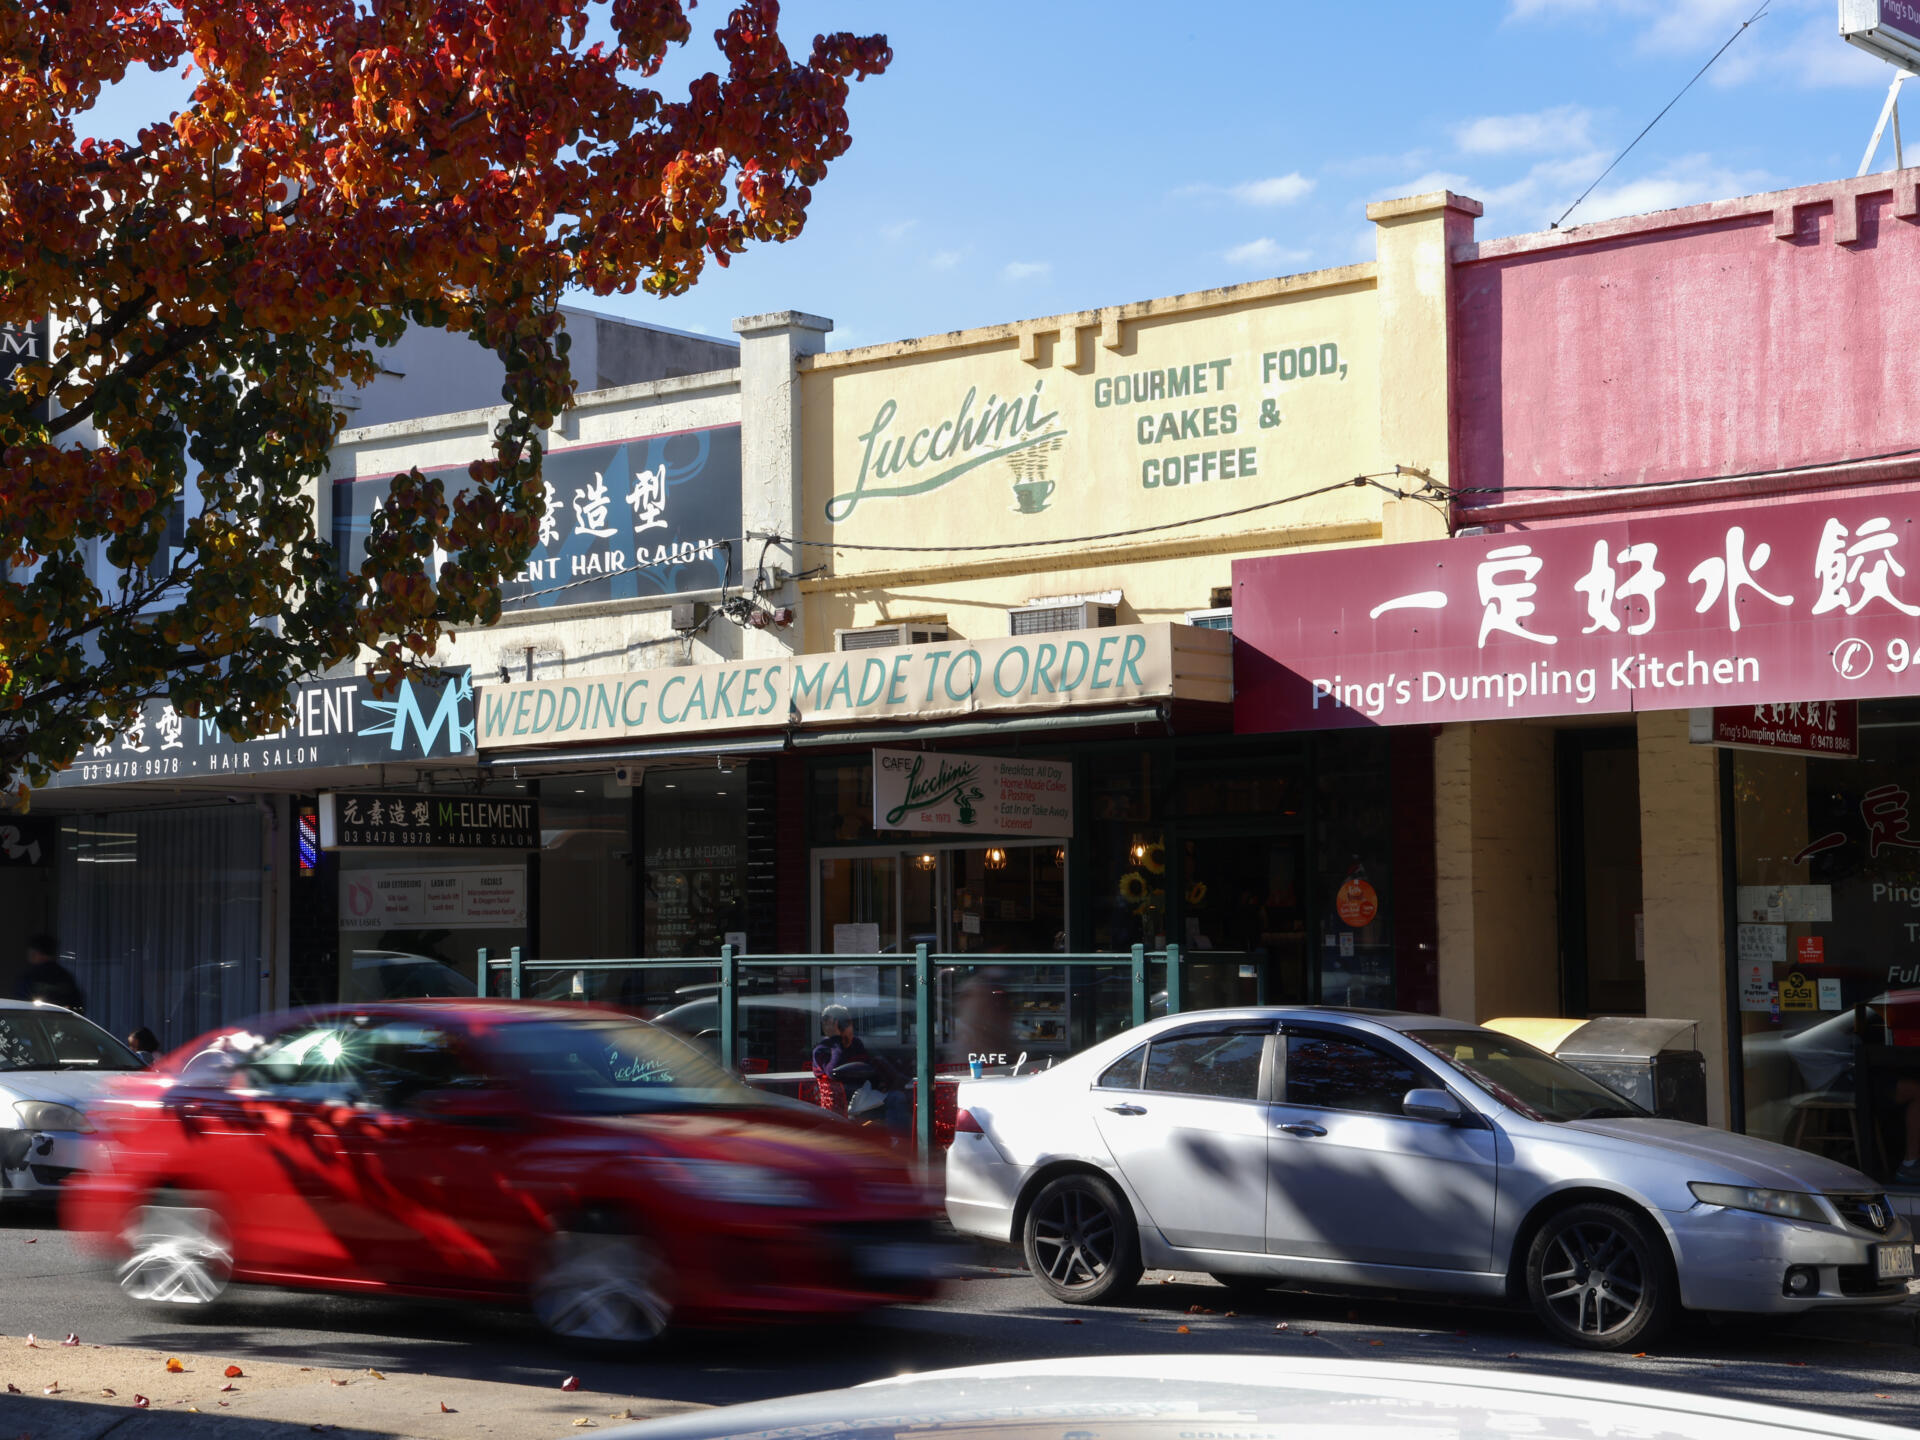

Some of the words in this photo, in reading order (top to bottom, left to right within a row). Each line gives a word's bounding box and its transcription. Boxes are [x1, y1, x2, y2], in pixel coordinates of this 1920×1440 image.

[1095, 358, 1231, 408] GOURMET
[1263, 342, 1348, 384] FOOD,
[1138, 404, 1238, 445] CAKES
[1258, 399, 1281, 429] &
[825, 380, 1067, 522] Lucchini
[1142, 447, 1257, 489] COFFEE
[571, 550, 626, 576] HAIR
[636, 538, 714, 566] SALON
[485, 680, 648, 737] WEDDING
[658, 665, 782, 724] CAKES
[789, 654, 913, 713] MADE
[924, 650, 982, 701] TO
[993, 634, 1146, 698] ORDER
[1312, 674, 1411, 716] Ping's
[1422, 661, 1597, 707] Dumpling
[1611, 650, 1760, 690] Kitchen
[1719, 722, 1741, 741] Ping's
[1742, 725, 1775, 745] Dumpling
[1776, 729, 1802, 745] Kitchen
[83, 765, 98, 780] 03
[105, 761, 138, 777] 9478
[145, 758, 179, 775] 9978
[210, 752, 250, 770] HAIR
[263, 746, 318, 766] SALON
[882, 757, 912, 770] CAFE
[1000, 764, 1034, 777] Breakfast
[1037, 766, 1047, 778] All
[1048, 767, 1062, 781] Day
[887, 755, 980, 824] Lucchini
[1000, 778, 1023, 790] Home
[1025, 779, 1045, 791] Made
[1045, 780, 1067, 792] Cakes
[343, 798, 431, 827] 元素造型
[438, 802, 532, 829] M-ELEMENT
[1000, 802, 1013, 815] Eat
[1013, 803, 1021, 815] In
[1022, 806, 1030, 816] or
[1031, 804, 1048, 816] Take
[1048, 805, 1069, 819] Away
[344, 830, 358, 843] 03
[365, 831, 395, 844] 9478
[402, 832, 431, 844] 9978
[449, 833, 482, 845] HAIR
[492, 833, 533, 846] SALON
[1904, 923, 1920, 943] T
[1784, 988, 1812, 998] EASI
[968, 1053, 1007, 1065] CAFE
